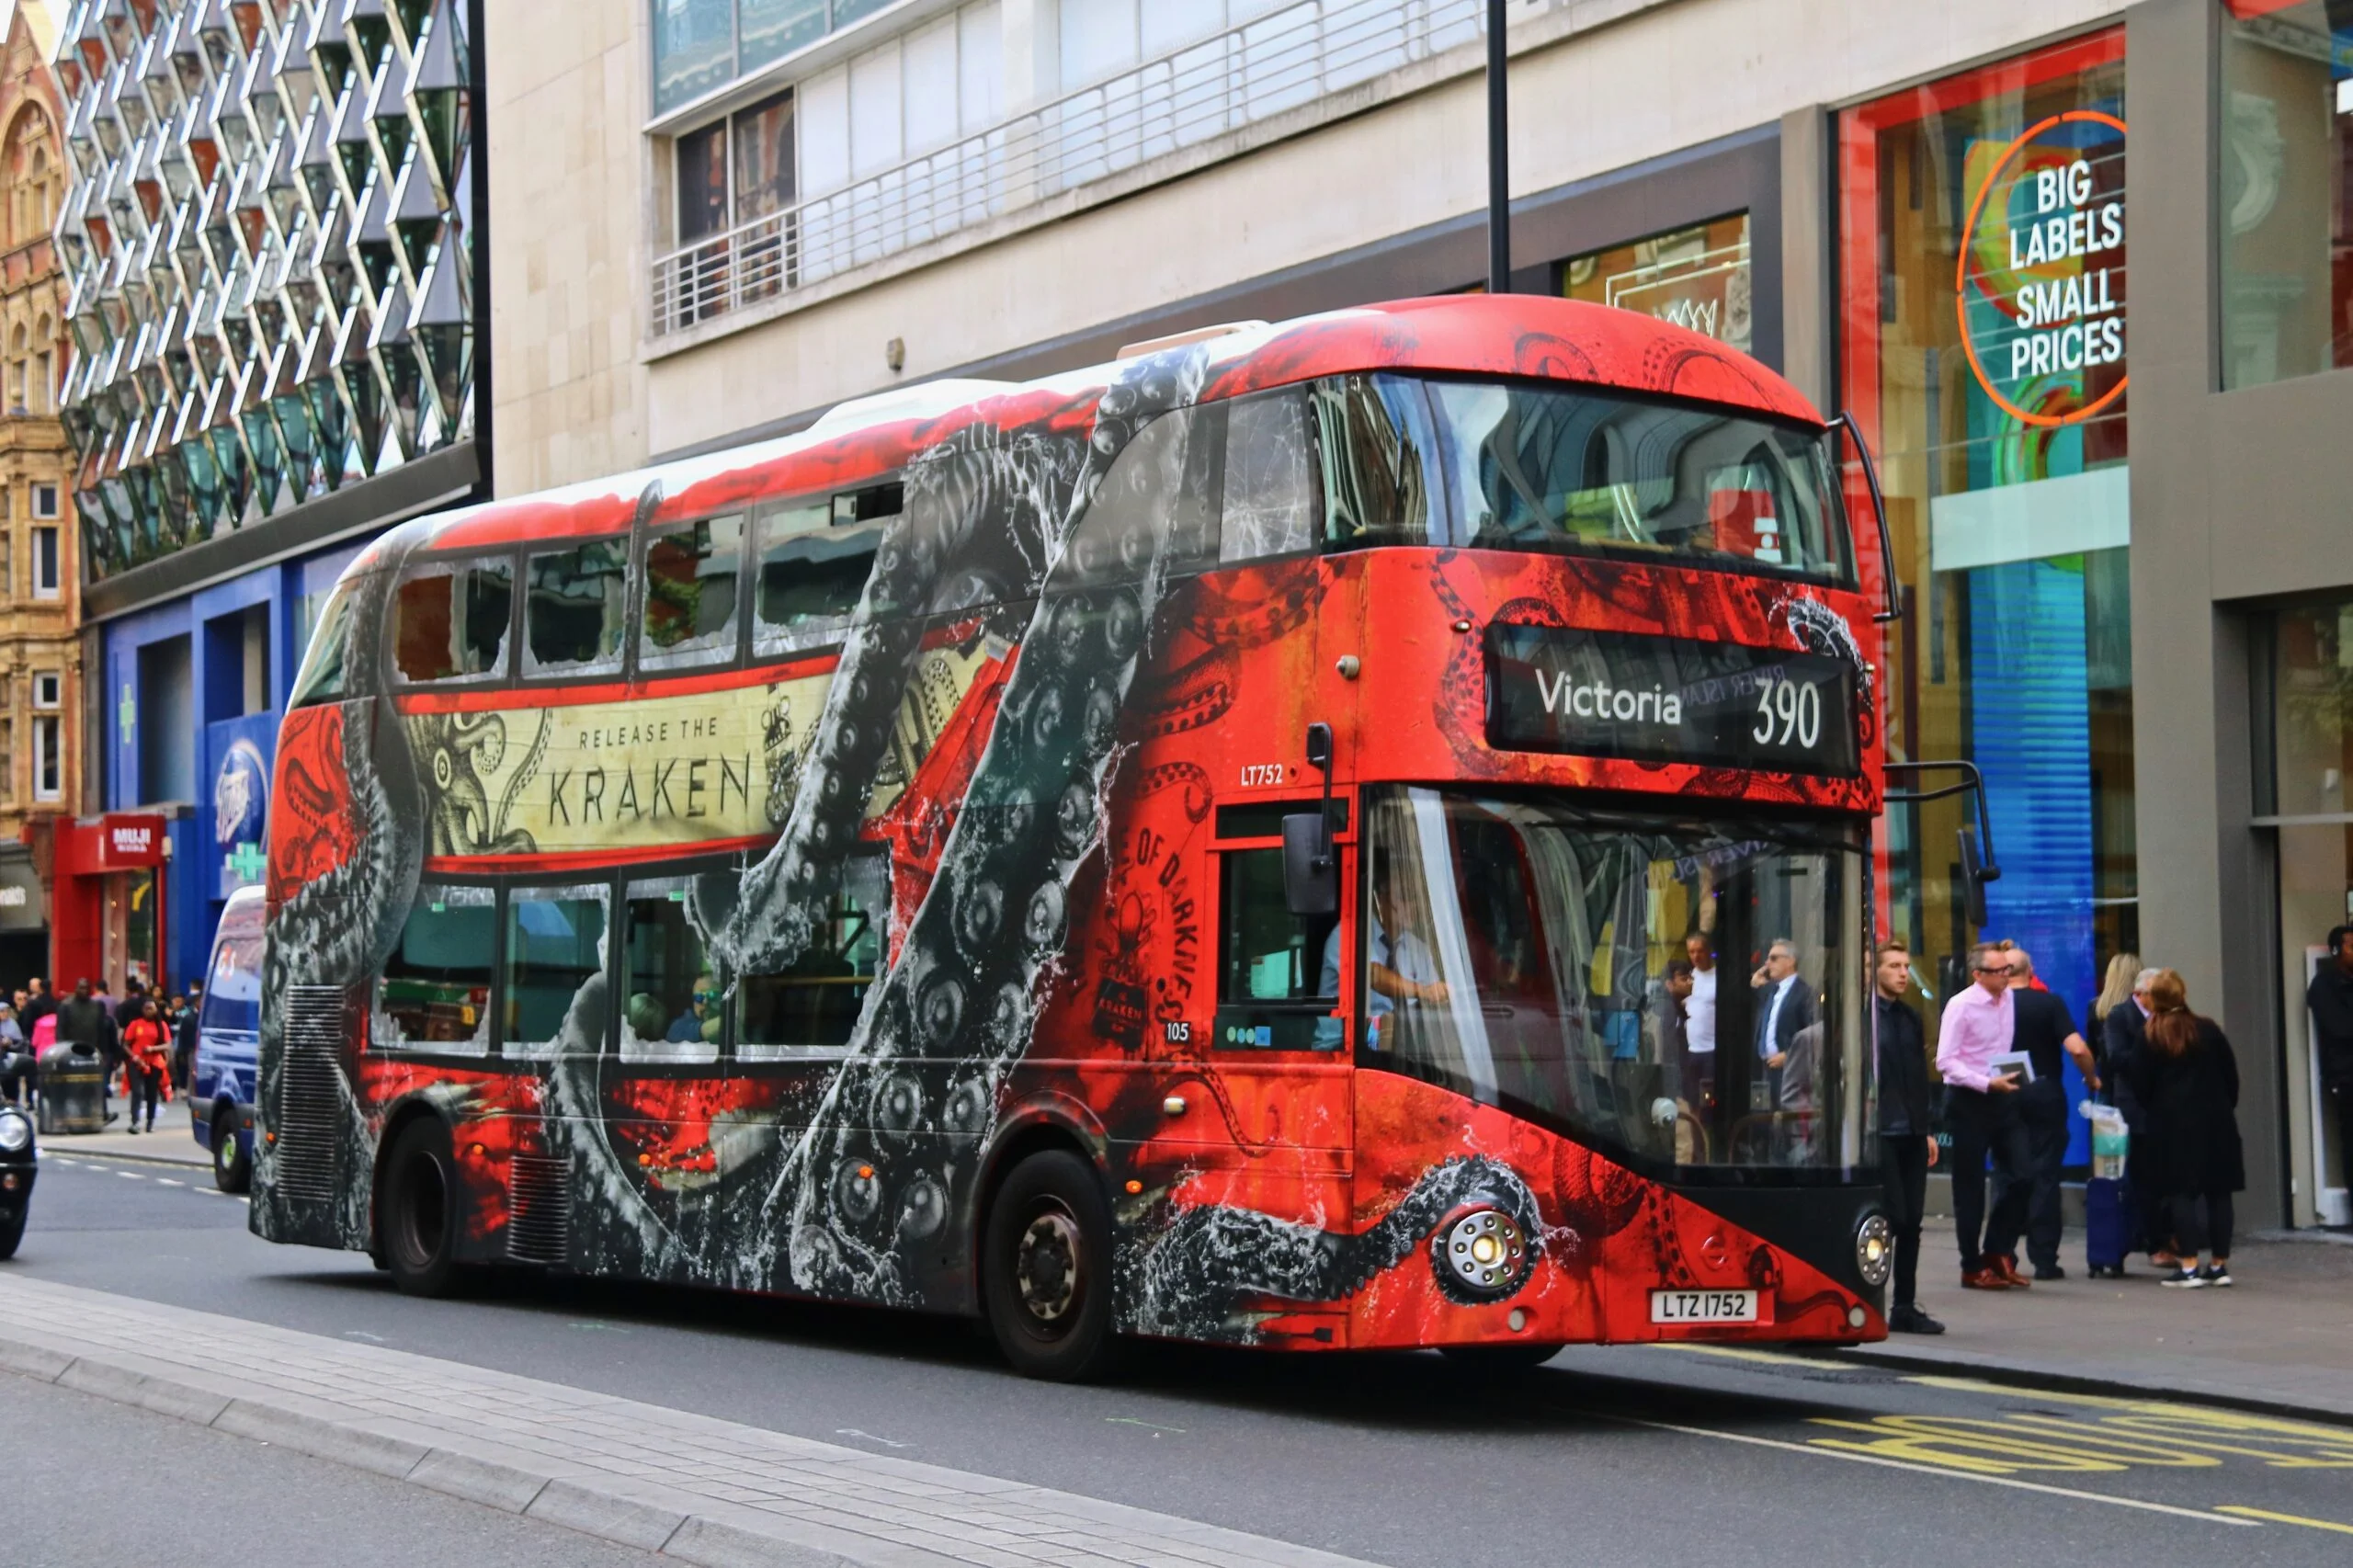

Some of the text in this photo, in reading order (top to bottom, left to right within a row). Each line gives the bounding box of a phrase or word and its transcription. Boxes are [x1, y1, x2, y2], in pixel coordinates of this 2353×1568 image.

[2037, 160, 2093, 213] BIG
[2009, 202, 2123, 271] LABELS
[2016, 268, 2116, 330] SMALL
[2011, 317, 2123, 381] PRICES
[580, 717, 717, 750] RELEASE THE
[1535, 668, 1820, 748] Victoria 390
[550, 750, 751, 826] KRAKEN
[1241, 763, 1283, 787] LT752
[1137, 827, 1165, 867] OF
[1167, 1022, 1188, 1040] 105
